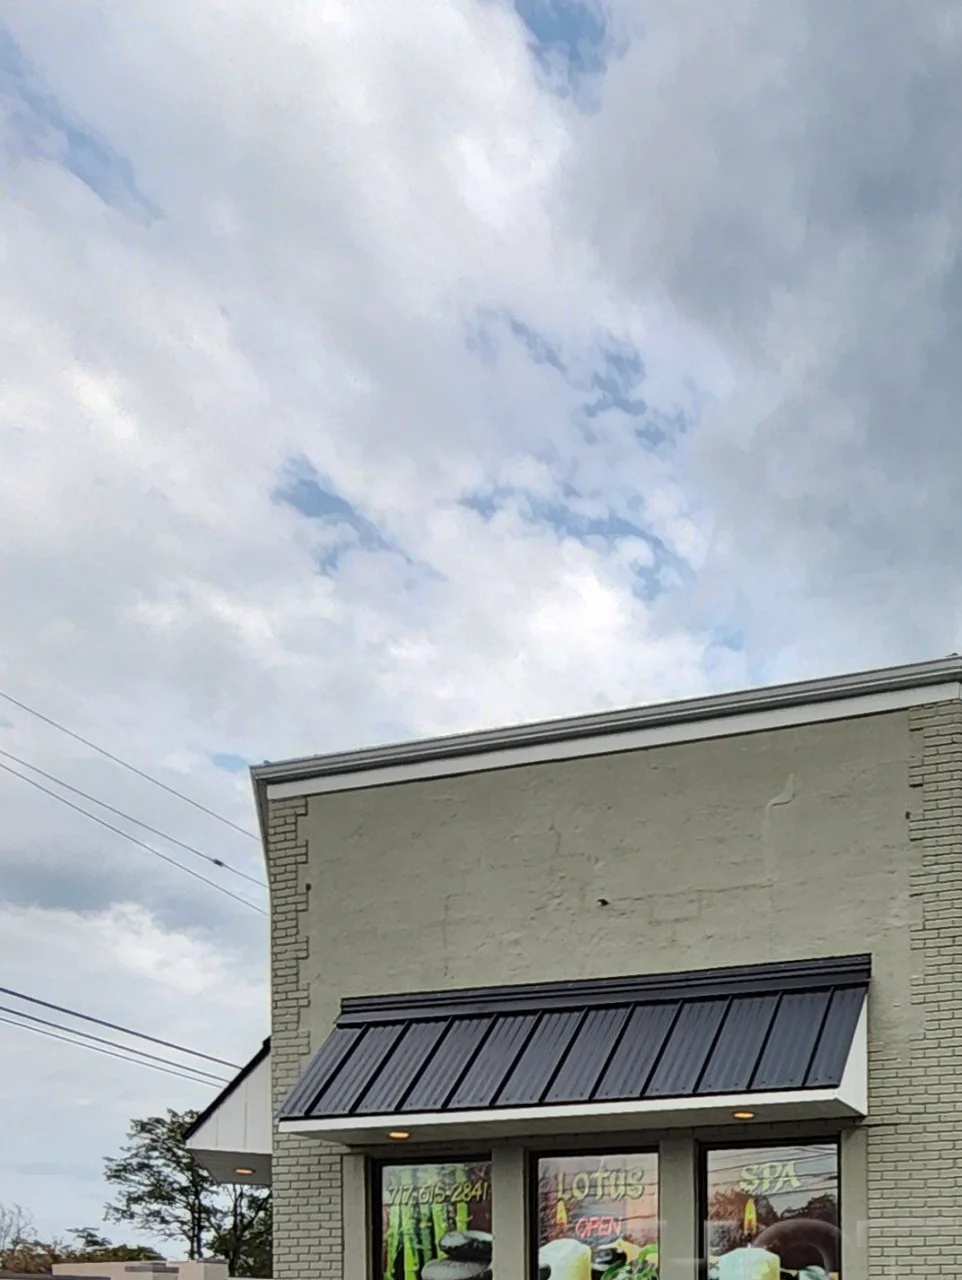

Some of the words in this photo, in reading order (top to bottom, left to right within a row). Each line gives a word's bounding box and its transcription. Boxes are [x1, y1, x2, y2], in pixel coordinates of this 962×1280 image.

[388, 1180, 489, 1206] 717-615-2841
[557, 1167, 646, 1201] LOTUS
[739, 1161, 801, 1195] SPA
[576, 1216, 622, 1238] OPEN
